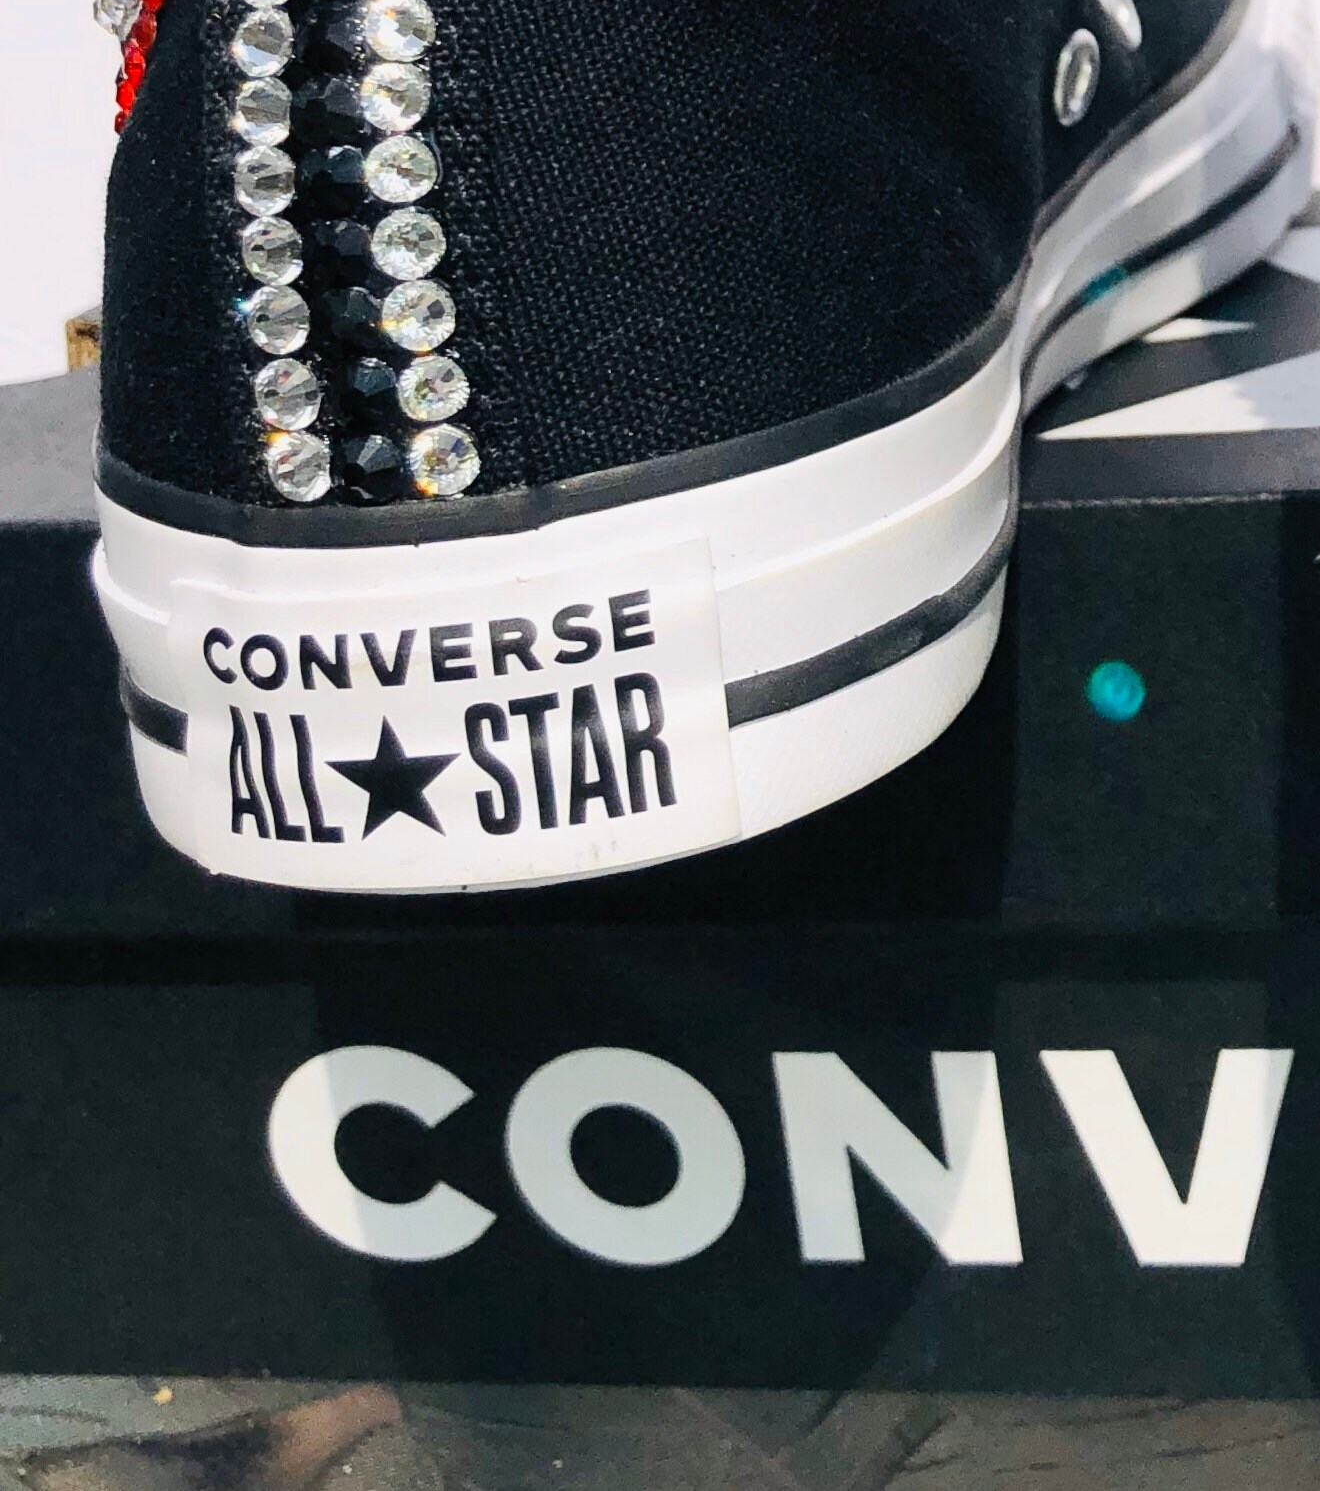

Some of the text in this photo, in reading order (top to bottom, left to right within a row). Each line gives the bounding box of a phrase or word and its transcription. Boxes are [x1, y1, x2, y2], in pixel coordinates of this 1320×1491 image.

[202, 588, 657, 691] CONVERSE
[228, 671, 678, 844] ALL STAR
